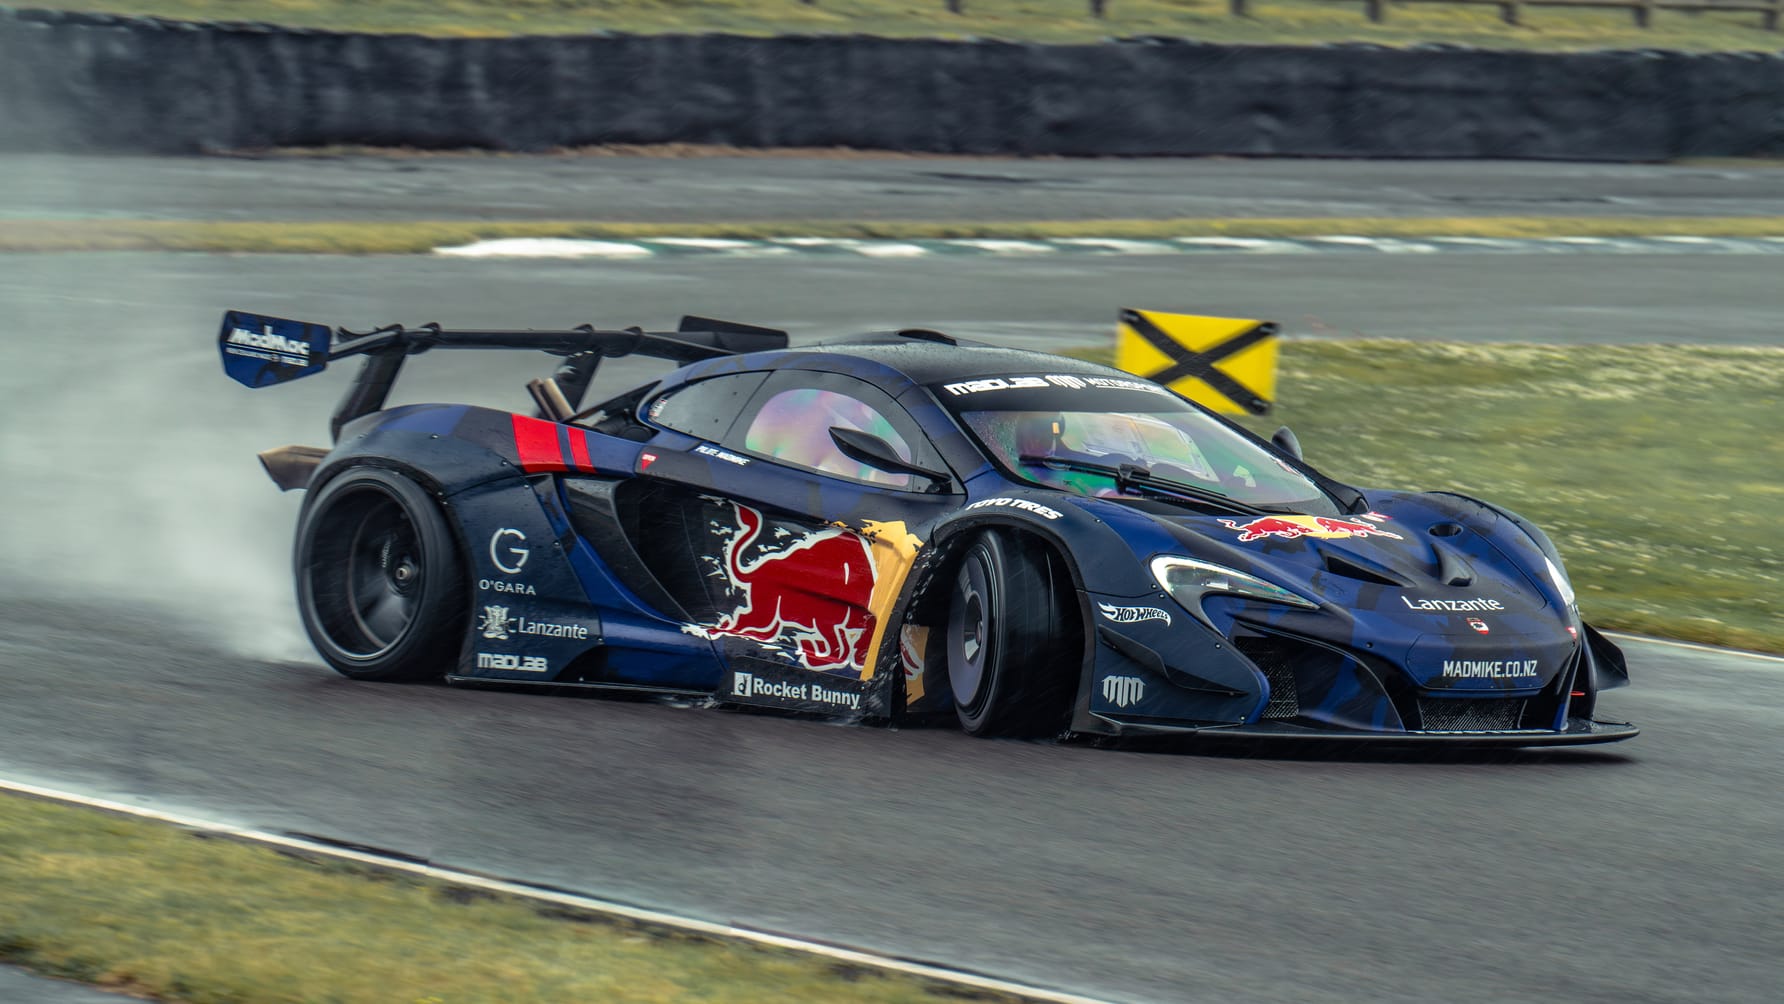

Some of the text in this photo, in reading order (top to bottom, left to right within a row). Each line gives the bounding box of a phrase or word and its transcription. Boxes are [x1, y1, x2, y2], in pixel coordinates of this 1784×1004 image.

[965, 498, 1064, 520] TOYO TIRES
[478, 579, 537, 596] O'GARA
[1401, 596, 1505, 611] Lanzante
[518, 617, 588, 639] Lanzante
[1442, 660, 1538, 678] MADMIKE.CO.NZ
[753, 678, 861, 709] Rocket Bunny
